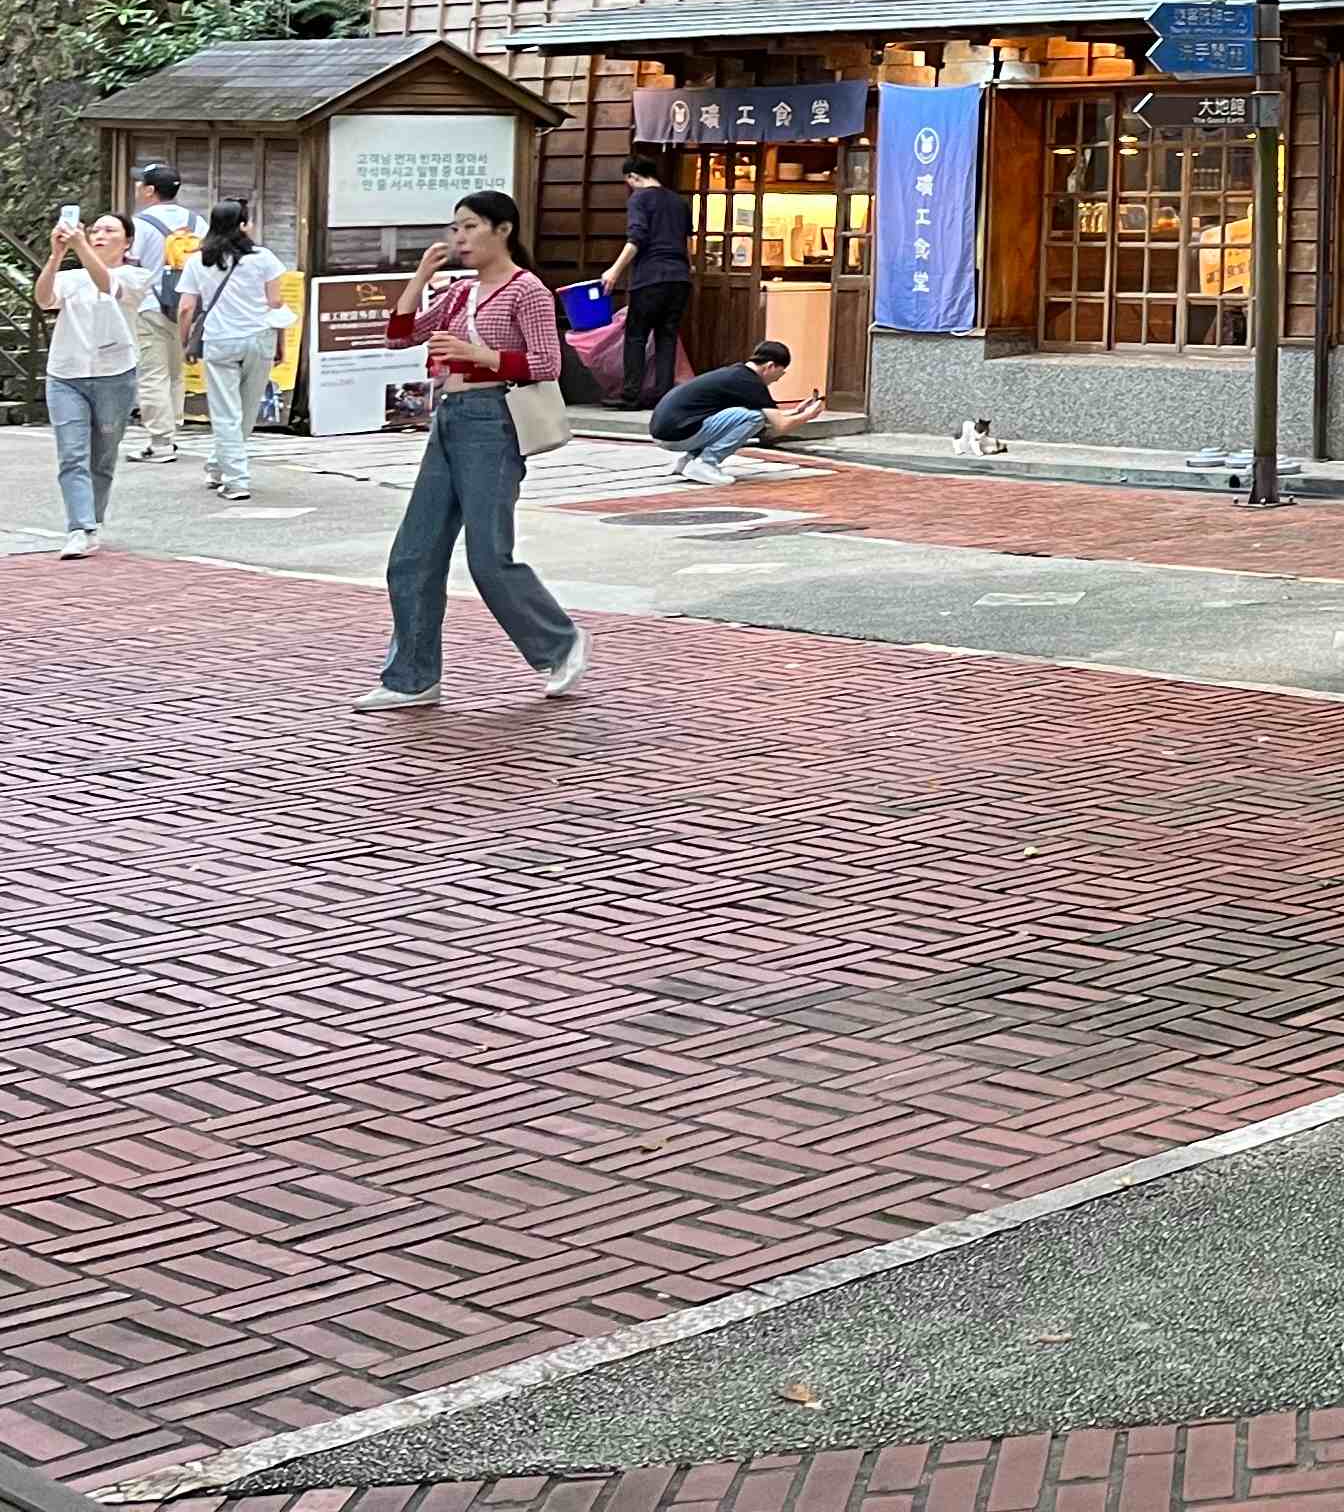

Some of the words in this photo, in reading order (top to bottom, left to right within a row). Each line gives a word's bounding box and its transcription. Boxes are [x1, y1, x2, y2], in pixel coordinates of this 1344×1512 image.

[700, 99, 831, 129] 礦工食堂
[1197, 97, 1246, 116] 大地館
[912, 173, 933, 292] 礦工食堂
